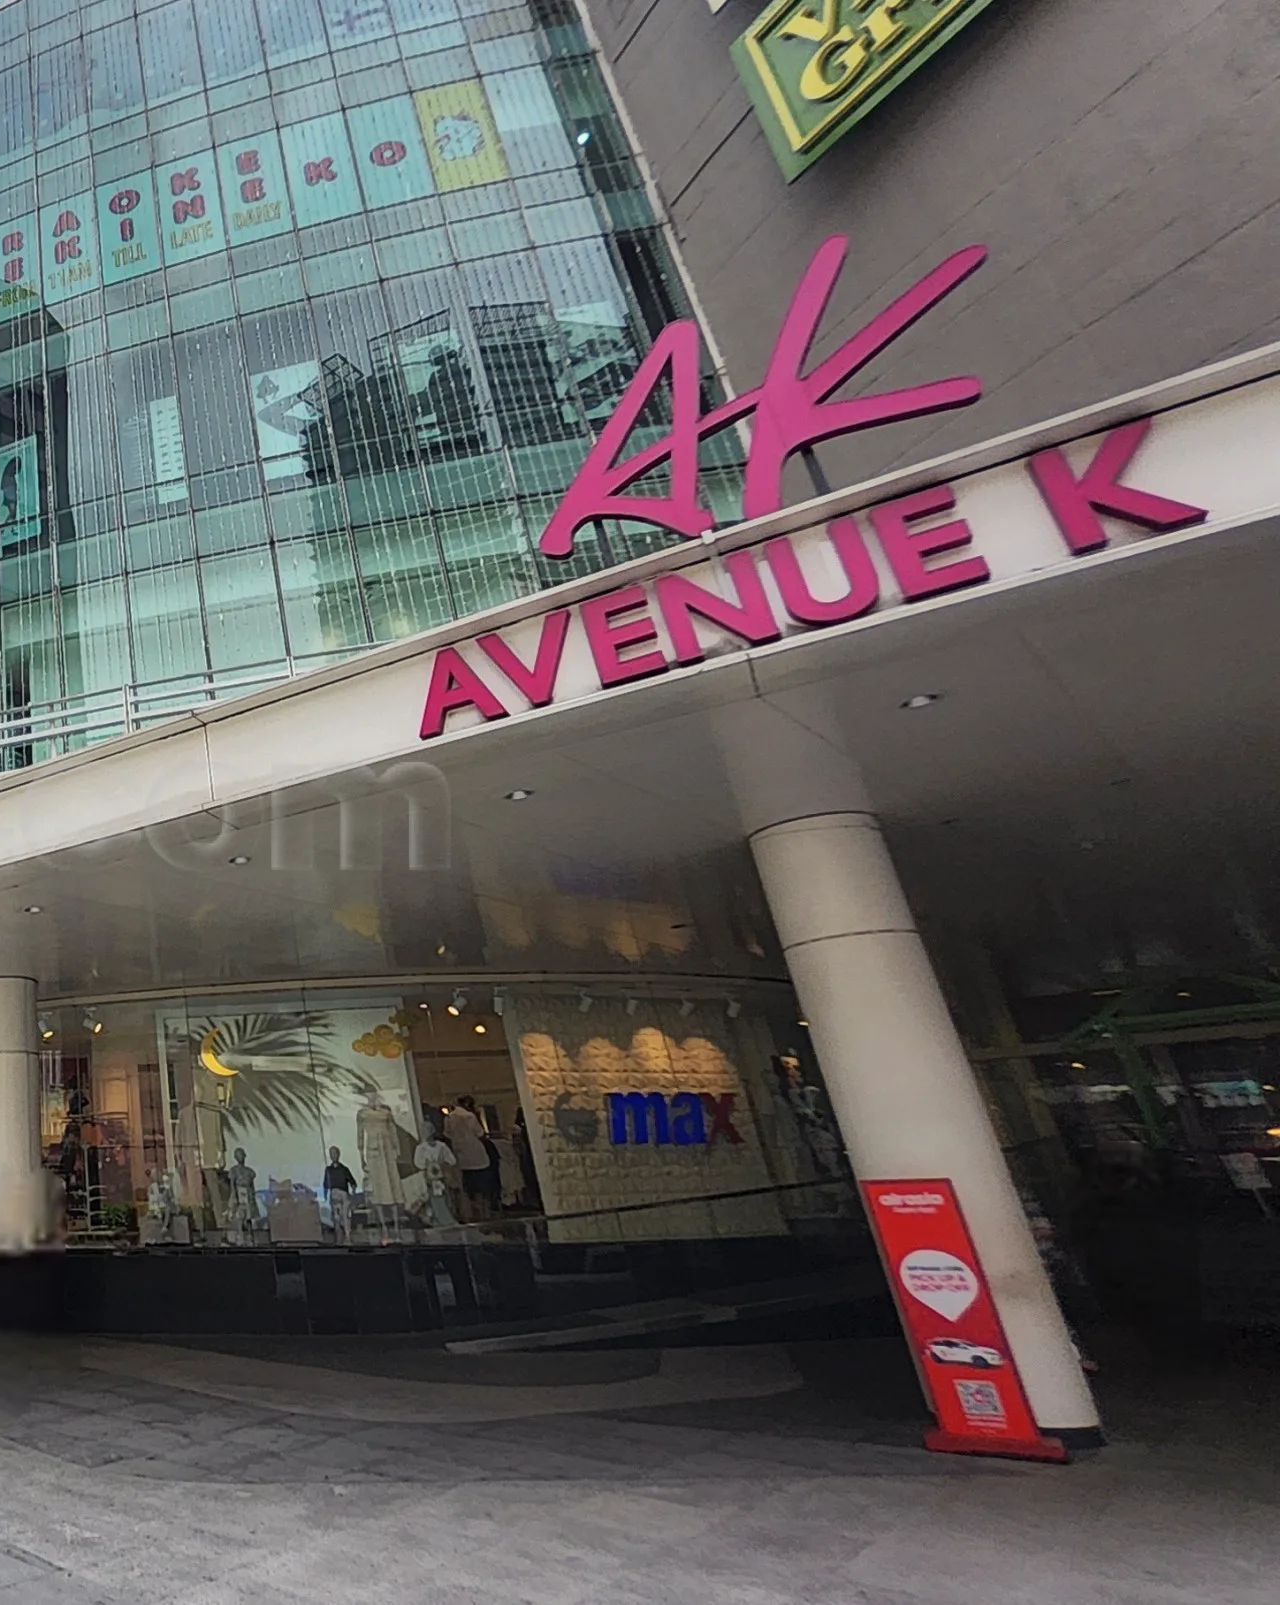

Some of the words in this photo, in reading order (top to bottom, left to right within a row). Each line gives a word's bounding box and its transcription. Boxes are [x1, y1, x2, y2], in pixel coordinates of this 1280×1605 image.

[112, 242, 147, 268] TILL
[171, 220, 214, 250] LATE
[233, 201, 283, 230] DAILY
[419, 486, 991, 740] AVENUE
[1028, 417, 1210, 556] K
[604, 1091, 746, 1145] max
